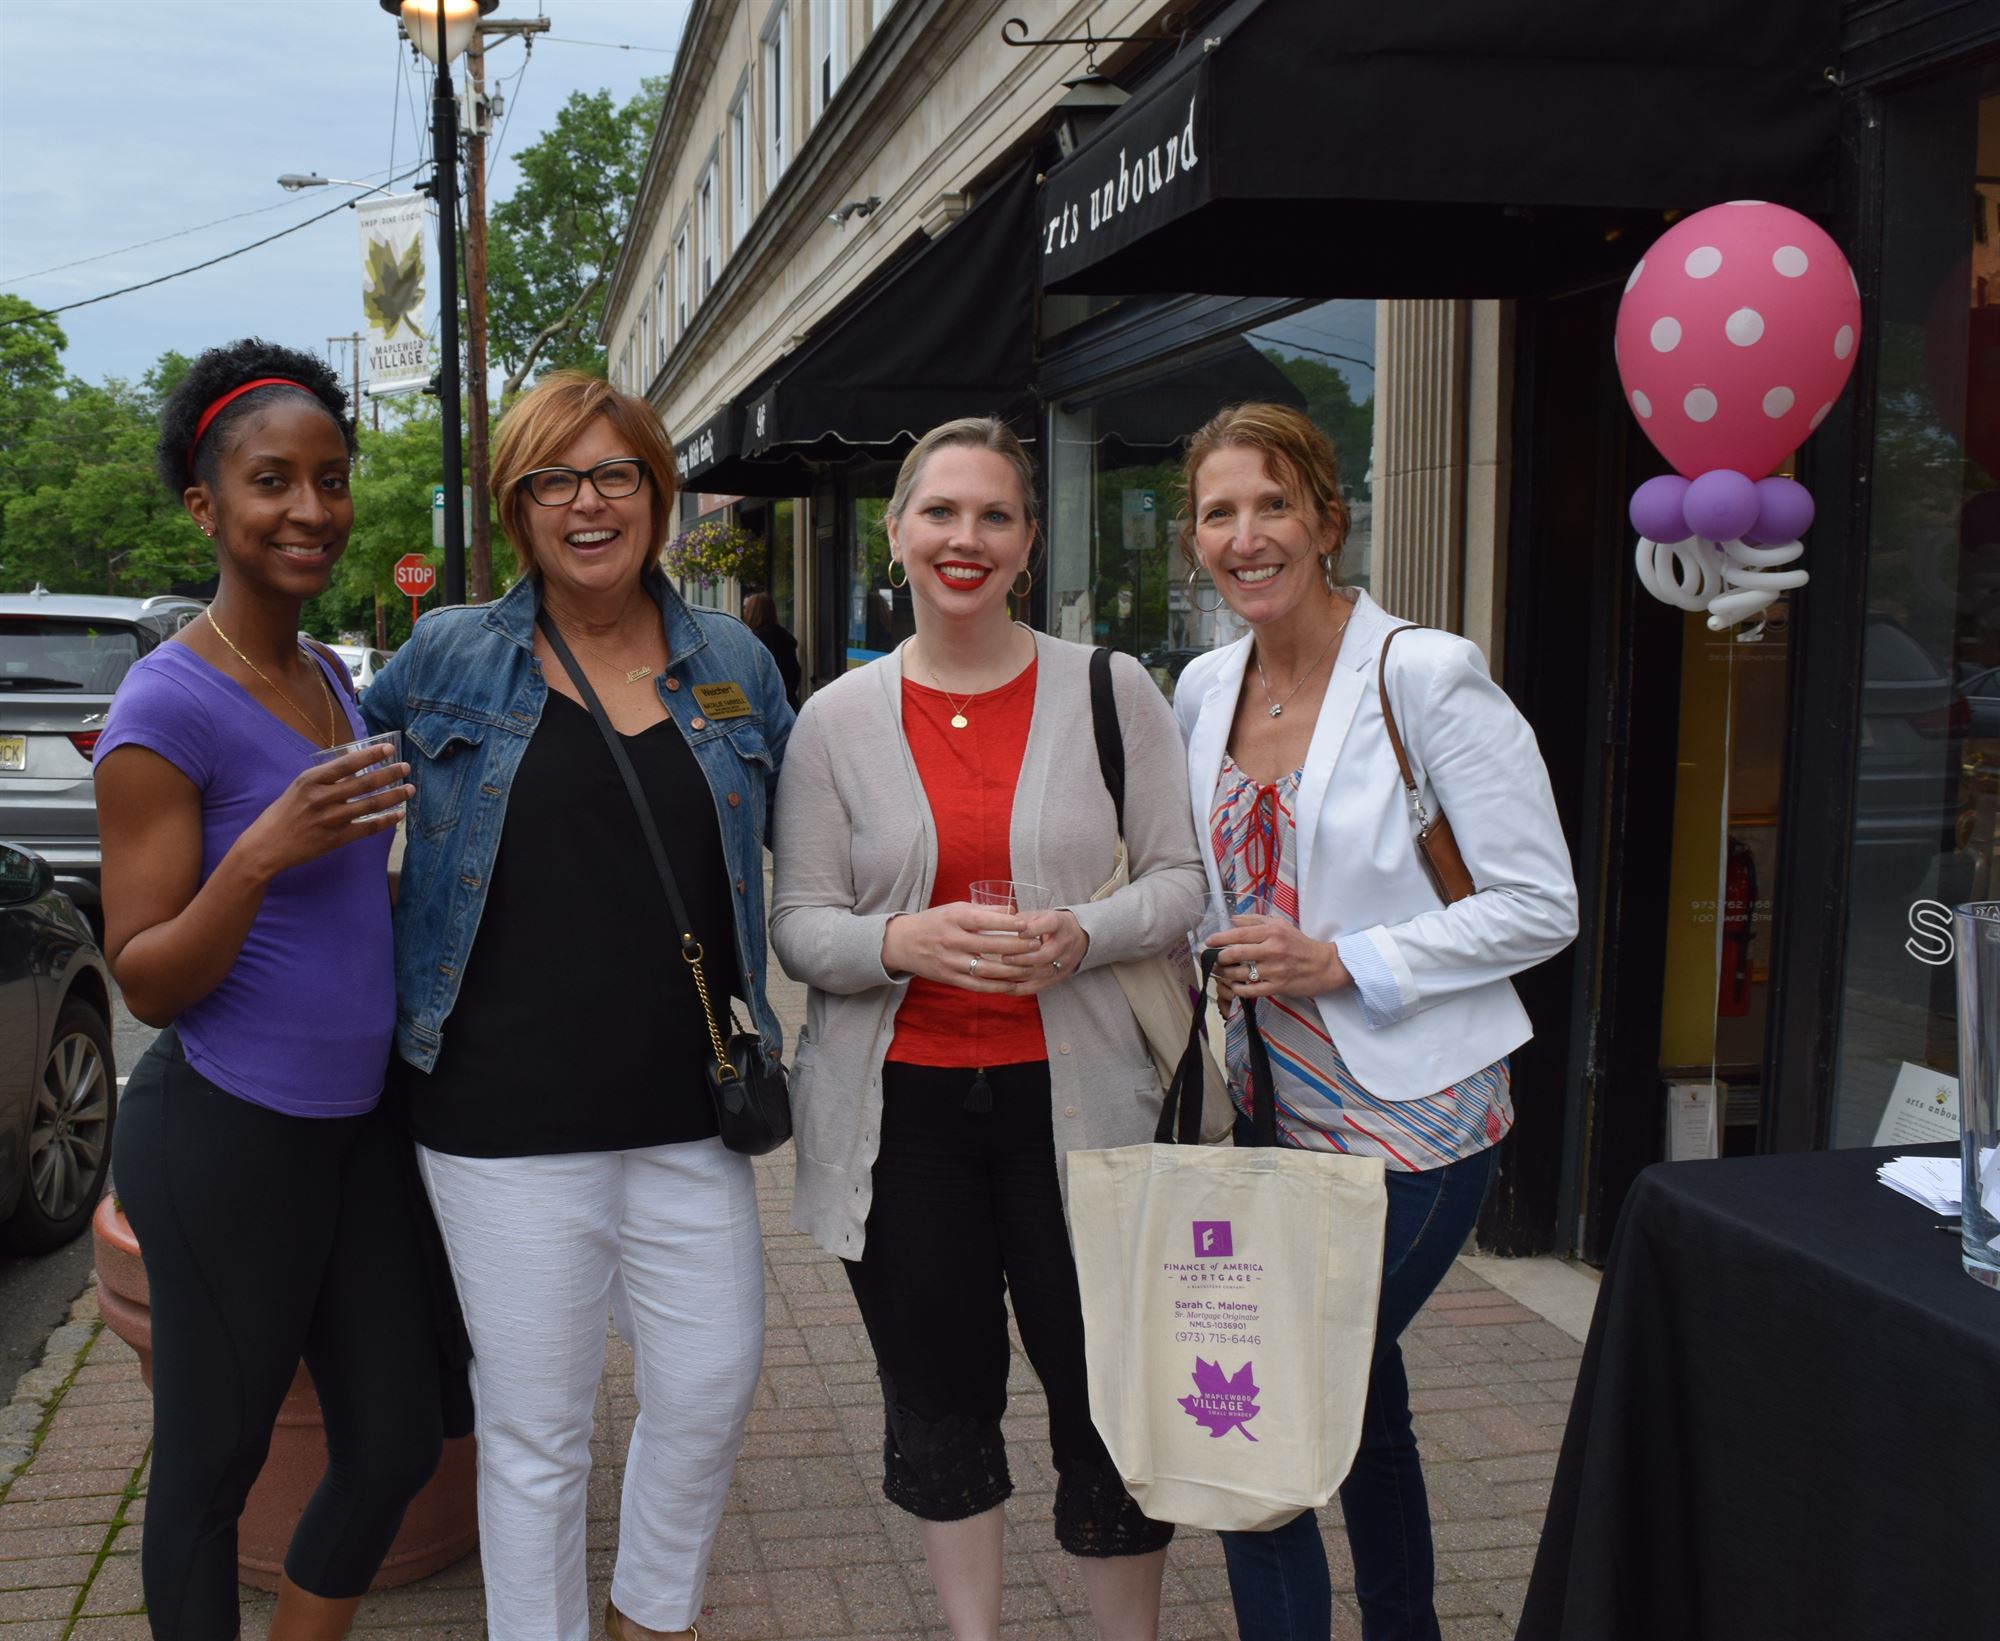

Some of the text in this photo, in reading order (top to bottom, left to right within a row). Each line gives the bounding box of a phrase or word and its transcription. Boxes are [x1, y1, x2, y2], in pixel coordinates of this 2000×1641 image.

[1043, 94, 1199, 255] rts unbound
[369, 349, 423, 371] VILLAGE
[397, 566, 433, 583] STOP
[1163, 1262, 1264, 1272] FINANCE of AMERICA
[1174, 1300, 1258, 1313] Sarah C. Maloney
[1174, 1311, 1260, 1321] Sr. Mortgage Originator
[1189, 1320, 1247, 1330] NMLS-1036901
[1175, 1331, 1262, 1346] (973) 715-6446
[1204, 1392, 1252, 1402] MAPLEWOOD
[1192, 1398, 1244, 1412] VILLAGE
